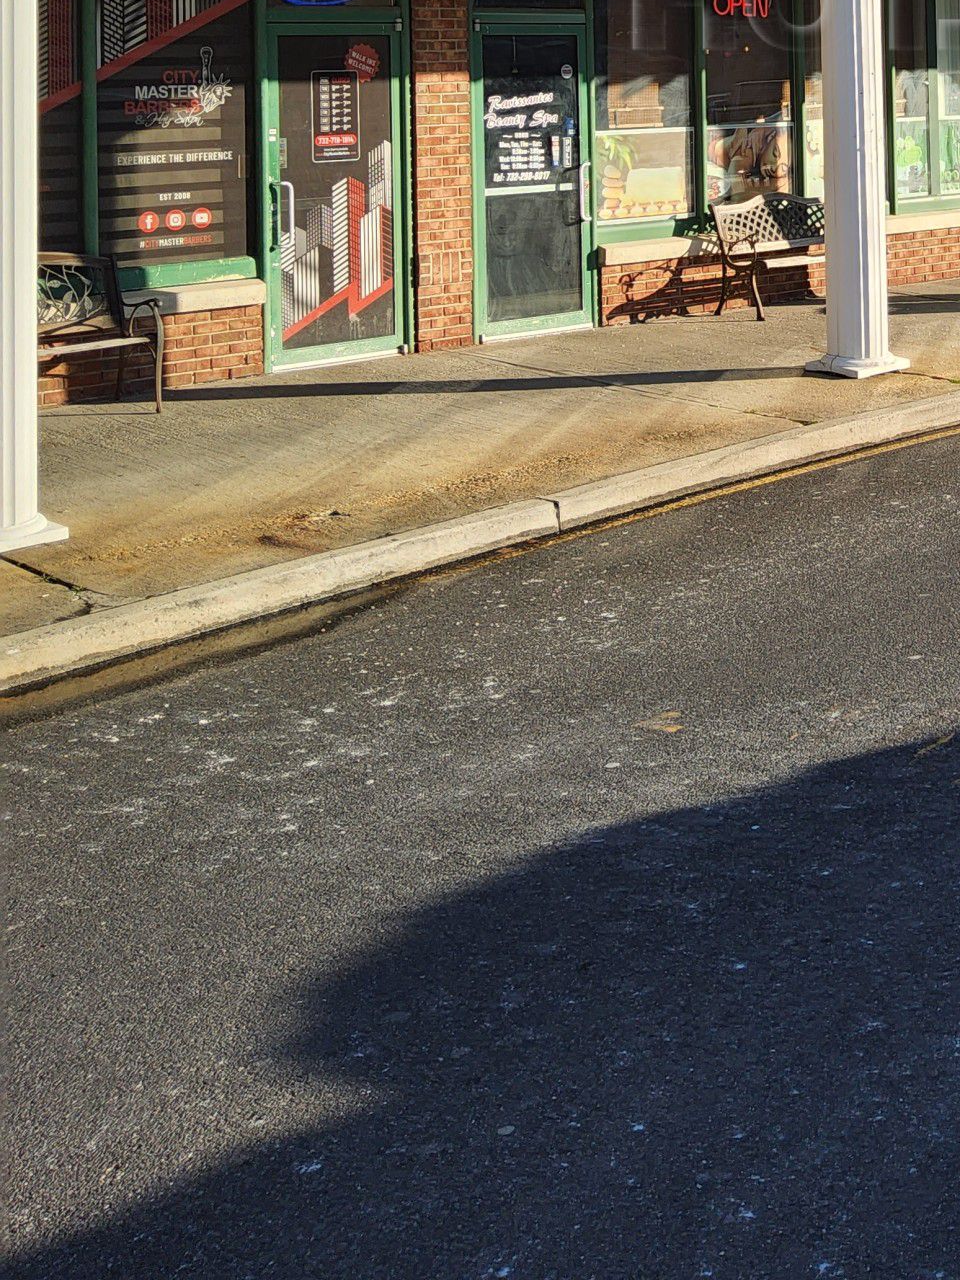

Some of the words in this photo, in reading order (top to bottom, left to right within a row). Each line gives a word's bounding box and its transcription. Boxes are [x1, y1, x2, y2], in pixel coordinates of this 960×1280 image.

[162, 70, 200, 83] CITY
[135, 85, 198, 99] MASTER
[124, 100, 201, 115] BARBERS
[483, 112, 527, 128] Beauty
[529, 110, 558, 127] Spa
[117, 154, 167, 165] EXPERIENCE
[169, 153, 184, 163] THE
[186, 151, 233, 162] DIFFERENCE
[140, 234, 212, 248] #CITYMASTERBARBERS
